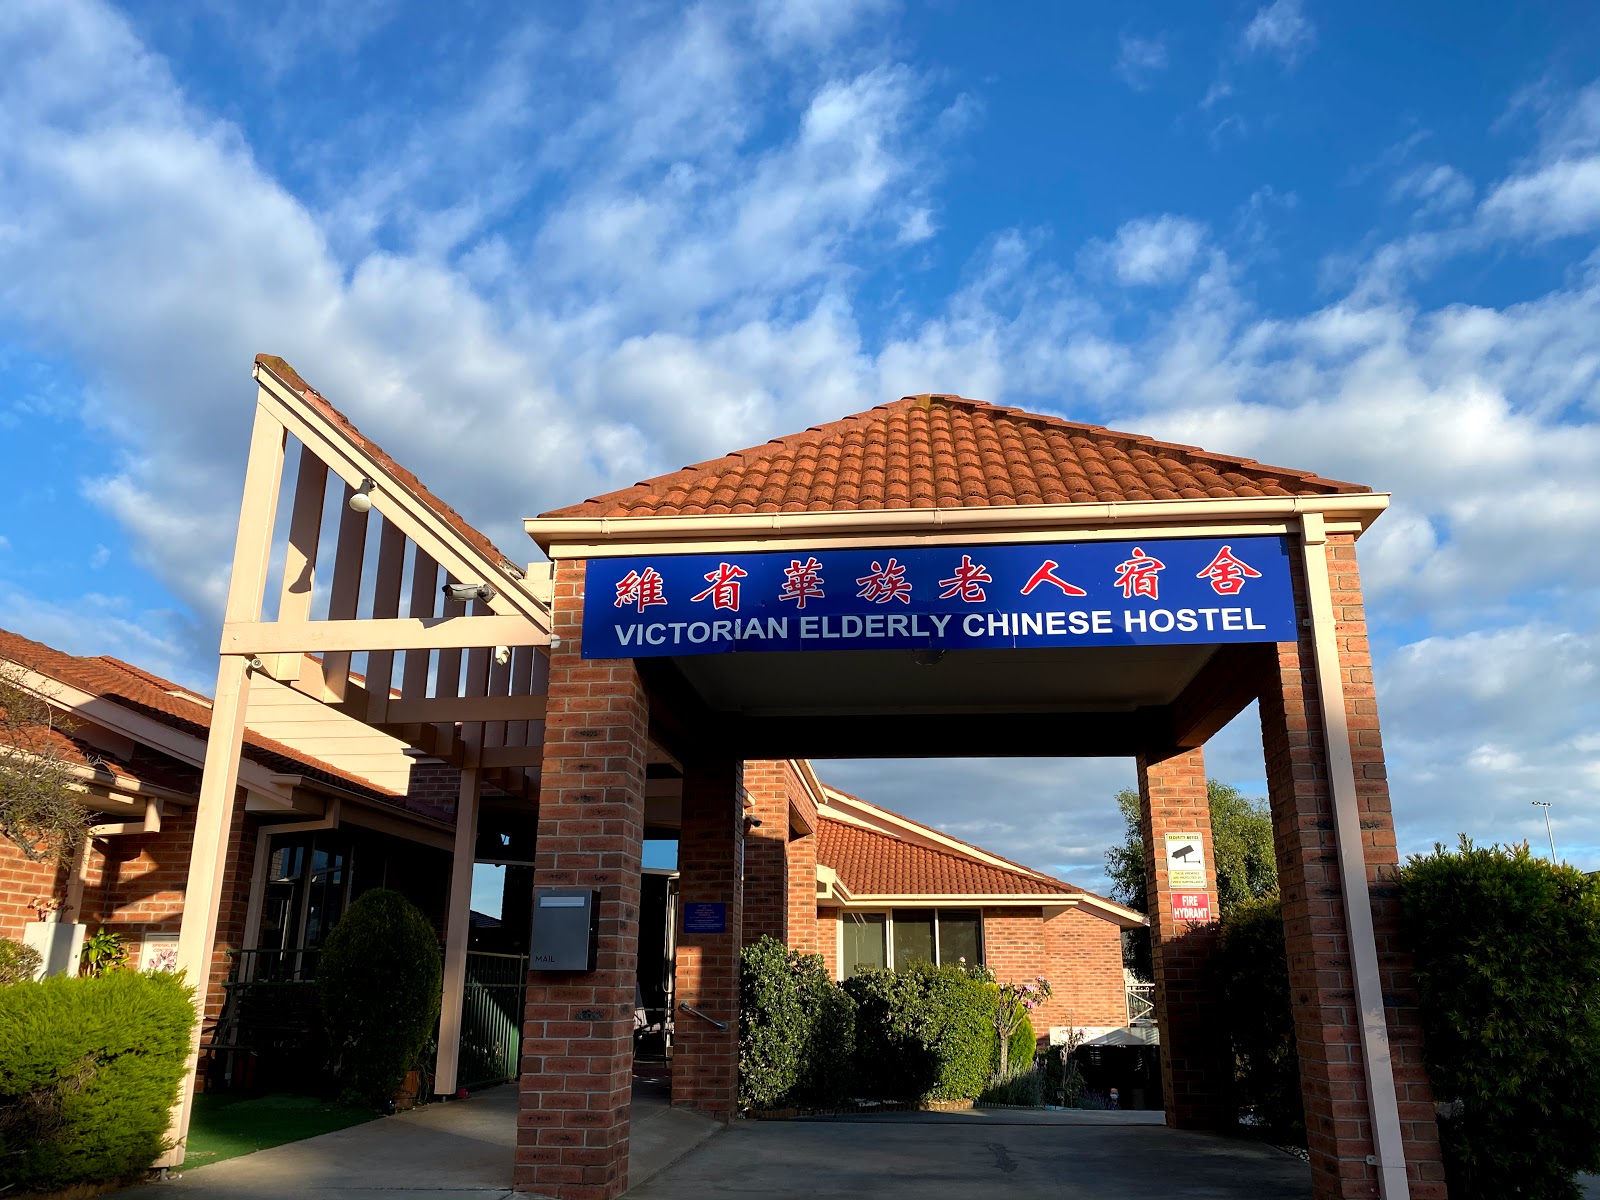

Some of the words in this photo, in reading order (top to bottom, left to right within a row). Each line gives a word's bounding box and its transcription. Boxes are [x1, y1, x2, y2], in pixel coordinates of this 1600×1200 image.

[614, 545, 1262, 614] 維省華族老人宿舍
[615, 616, 788, 646] VICTORIAN
[800, 613, 953, 639] ELDERLY
[962, 609, 1112, 637] CHINESE
[1124, 606, 1267, 633] HOSTEL
[1174, 908, 1207, 918] HYDRANT
[1182, 896, 1198, 906] FIRE
